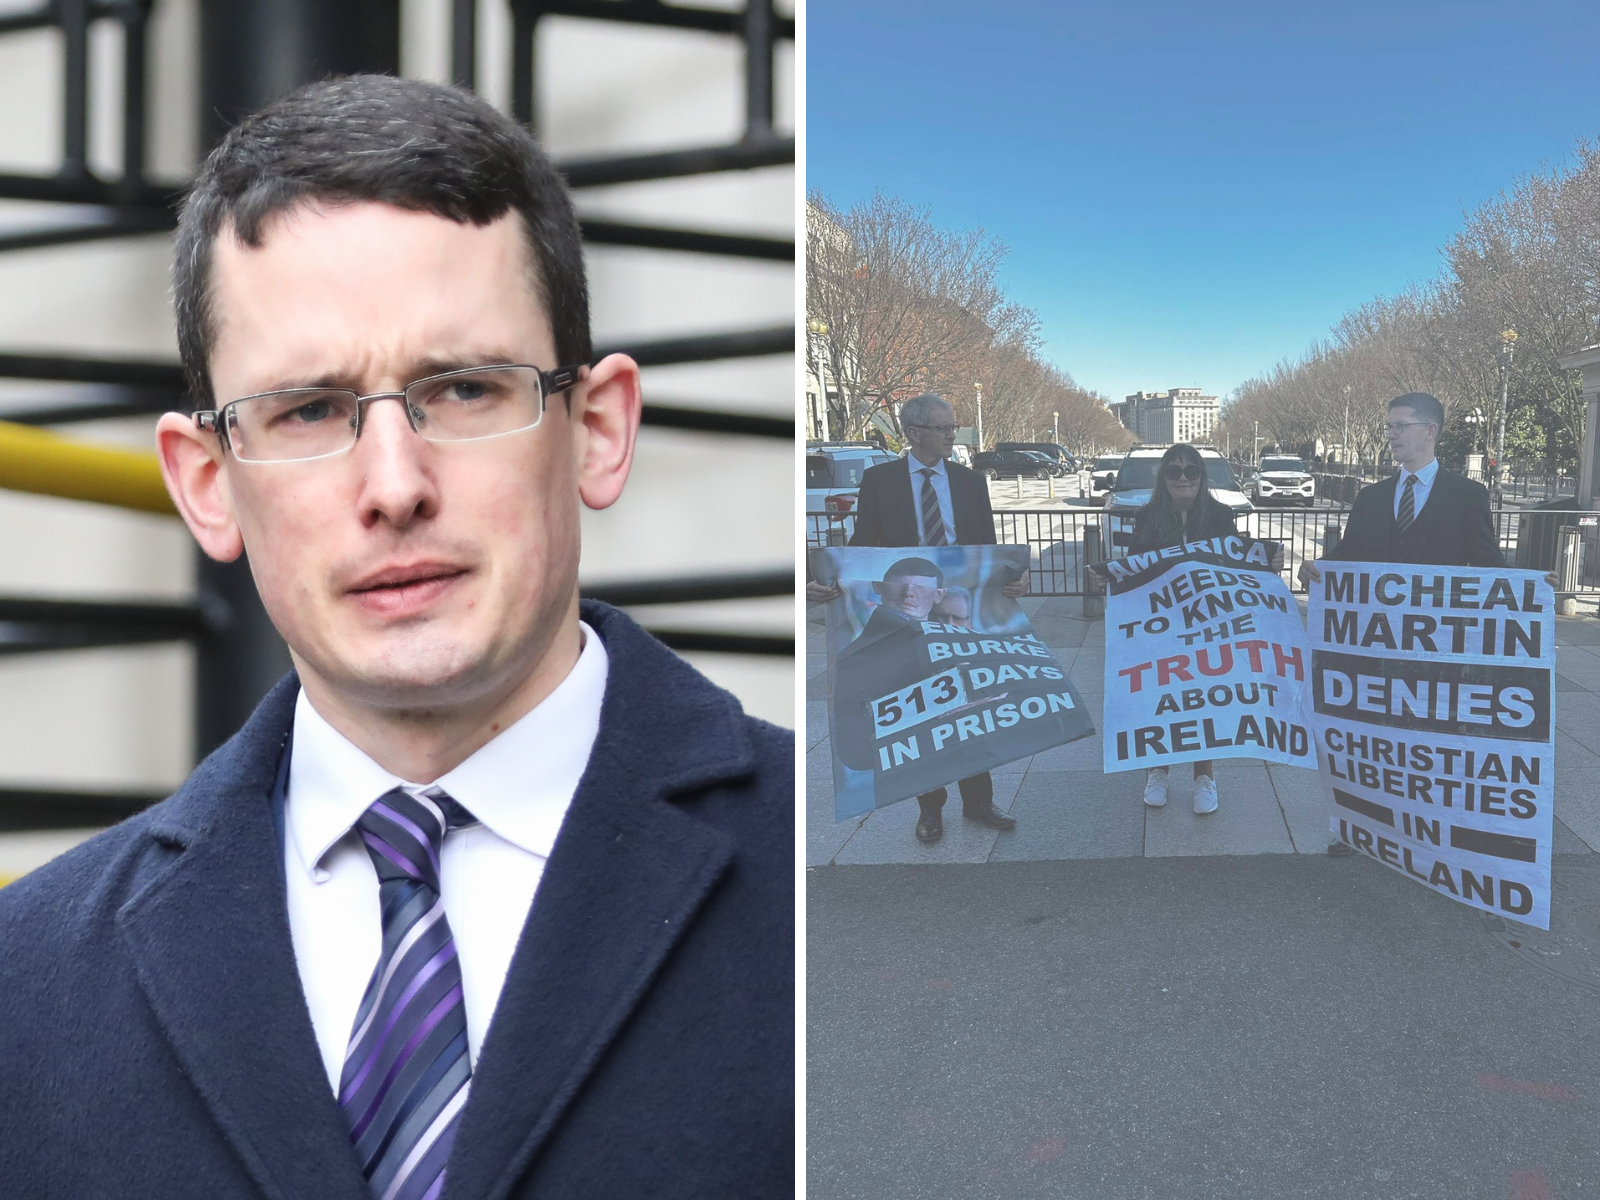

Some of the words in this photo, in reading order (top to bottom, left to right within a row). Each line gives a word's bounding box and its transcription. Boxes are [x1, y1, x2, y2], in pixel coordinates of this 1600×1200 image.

[1107, 535, 1269, 583] AMERICA
[1118, 616, 1170, 639] TO
[1181, 589, 1287, 630] KNOW
[1149, 568, 1261, 614] NEEDS
[1324, 571, 1544, 612] MICHEAL
[927, 640, 1051, 662] BURKE
[1176, 613, 1256, 646] THE
[1323, 608, 1541, 659] MARTIN
[1118, 639, 1305, 693] TRUTH
[875, 675, 959, 727] 513
[968, 664, 1064, 690] DAYS
[1155, 682, 1278, 716] ABOUT
[1322, 668, 1535, 728] DENIES
[879, 735, 920, 771] IN
[931, 692, 1075, 751] PRISON
[1116, 714, 1309, 761] IRELAND
[1324, 727, 1541, 786] CHRISTIAN
[1328, 754, 1537, 820] LIBERTIES
[1402, 812, 1441, 847] IN
[1339, 818, 1534, 916] IRELAND
